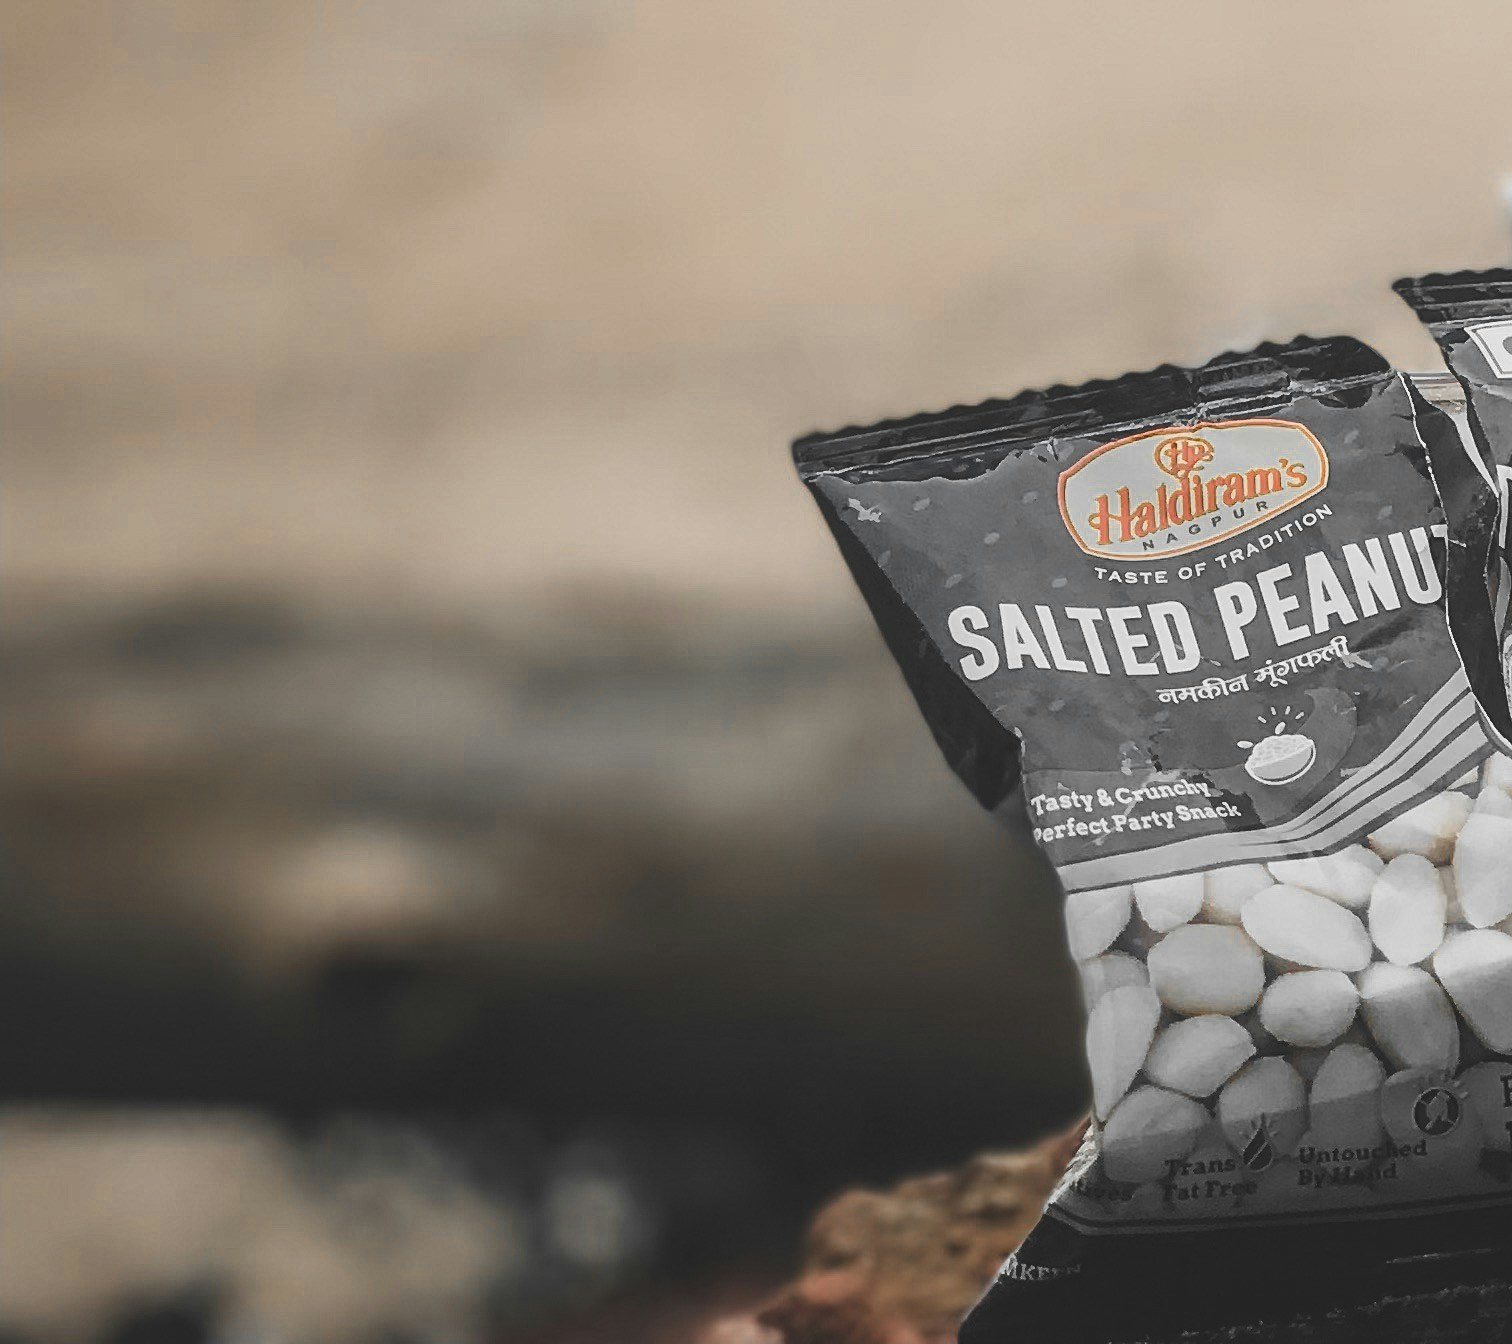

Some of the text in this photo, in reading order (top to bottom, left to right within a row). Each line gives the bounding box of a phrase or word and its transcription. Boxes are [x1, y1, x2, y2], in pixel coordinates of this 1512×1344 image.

[1088, 458, 1308, 545] Haldiram's
[1143, 500, 1269, 551] NAGPUR
[1094, 503, 1333, 585] TASTE OF TRADITION
[947, 600, 1200, 681] SALTED
[1156, 635, 1350, 704] नमकीन मूंगफली
[1030, 779, 1212, 816] Tasty & Crunchy
[1112, 811, 1176, 833] Party
[1175, 802, 1242, 821] Snack
[1165, 1158, 1236, 1177] Trans
